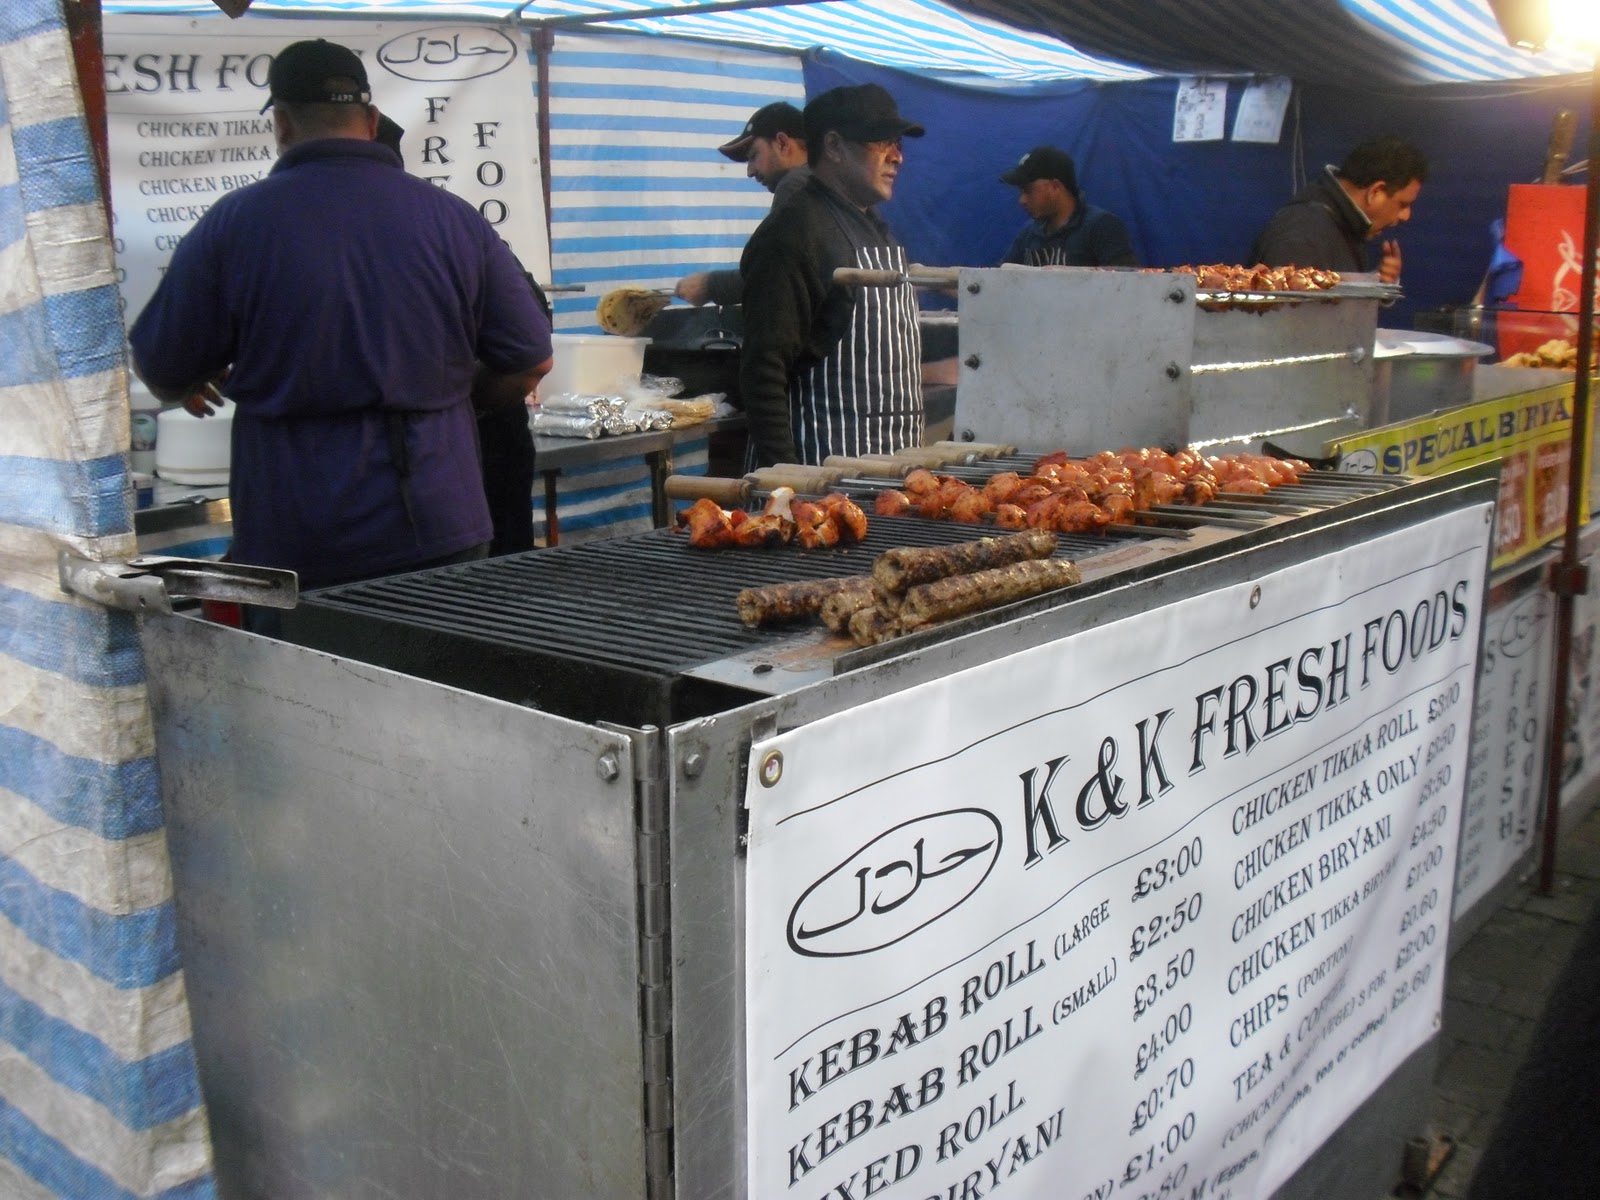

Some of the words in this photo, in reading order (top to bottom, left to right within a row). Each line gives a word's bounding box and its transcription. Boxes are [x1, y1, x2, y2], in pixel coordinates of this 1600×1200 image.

[103, 53, 203, 94] ESH
[137, 121, 218, 138] CHICKEN
[223, 118, 273, 136] TIKKA
[138, 150, 213, 168] CHICKEN
[219, 145, 271, 163] TIKKA
[139, 176, 217, 196] CHICKEN
[1382, 415, 1494, 474] SPECIAL
[1498, 396, 1571, 438] BIRYA
[1020, 753, 1072, 872] K
[1073, 734, 1130, 834] &
[1133, 706, 1176, 812] K
[1187, 632, 1353, 778] FRESH
[1360, 579, 1470, 692] FOODS
[1231, 763, 1318, 836] CHICKEN
[1322, 731, 1373, 784] TIKKA
[1375, 708, 1419, 751] ROLL
[1233, 812, 1312, 892] CHICKEN
[1315, 778, 1374, 833] TIKKA
[1376, 744, 1423, 796] ONLY
[1231, 861, 1314, 944] CHICKEN
[1318, 813, 1393, 883] BIRYANI
[787, 996, 949, 1114] KEBAB
[959, 939, 1046, 1018] ROLL
[1053, 898, 1111, 962] (LARGE
[1131, 836, 1204, 904] £3:00
[1227, 911, 1317, 997] CHICKEN
[1320, 890, 1361, 931] TIKKA
[786, 1066, 947, 1190] KEBAB
[956, 1006, 1044, 1089] ROLL
[1051, 956, 1119, 1027] (SMALL)
[1129, 892, 1204, 964] £2:50
[1133, 1002, 1194, 1080] £4:00
[1229, 984, 1291, 1049] CHIPS
[1129, 1056, 1195, 1137] £0:70
[1232, 1052, 1274, 1104] TEA
[935, 1079, 1027, 1164] ROLL
[1119, 1111, 1197, 1190] £1:00
